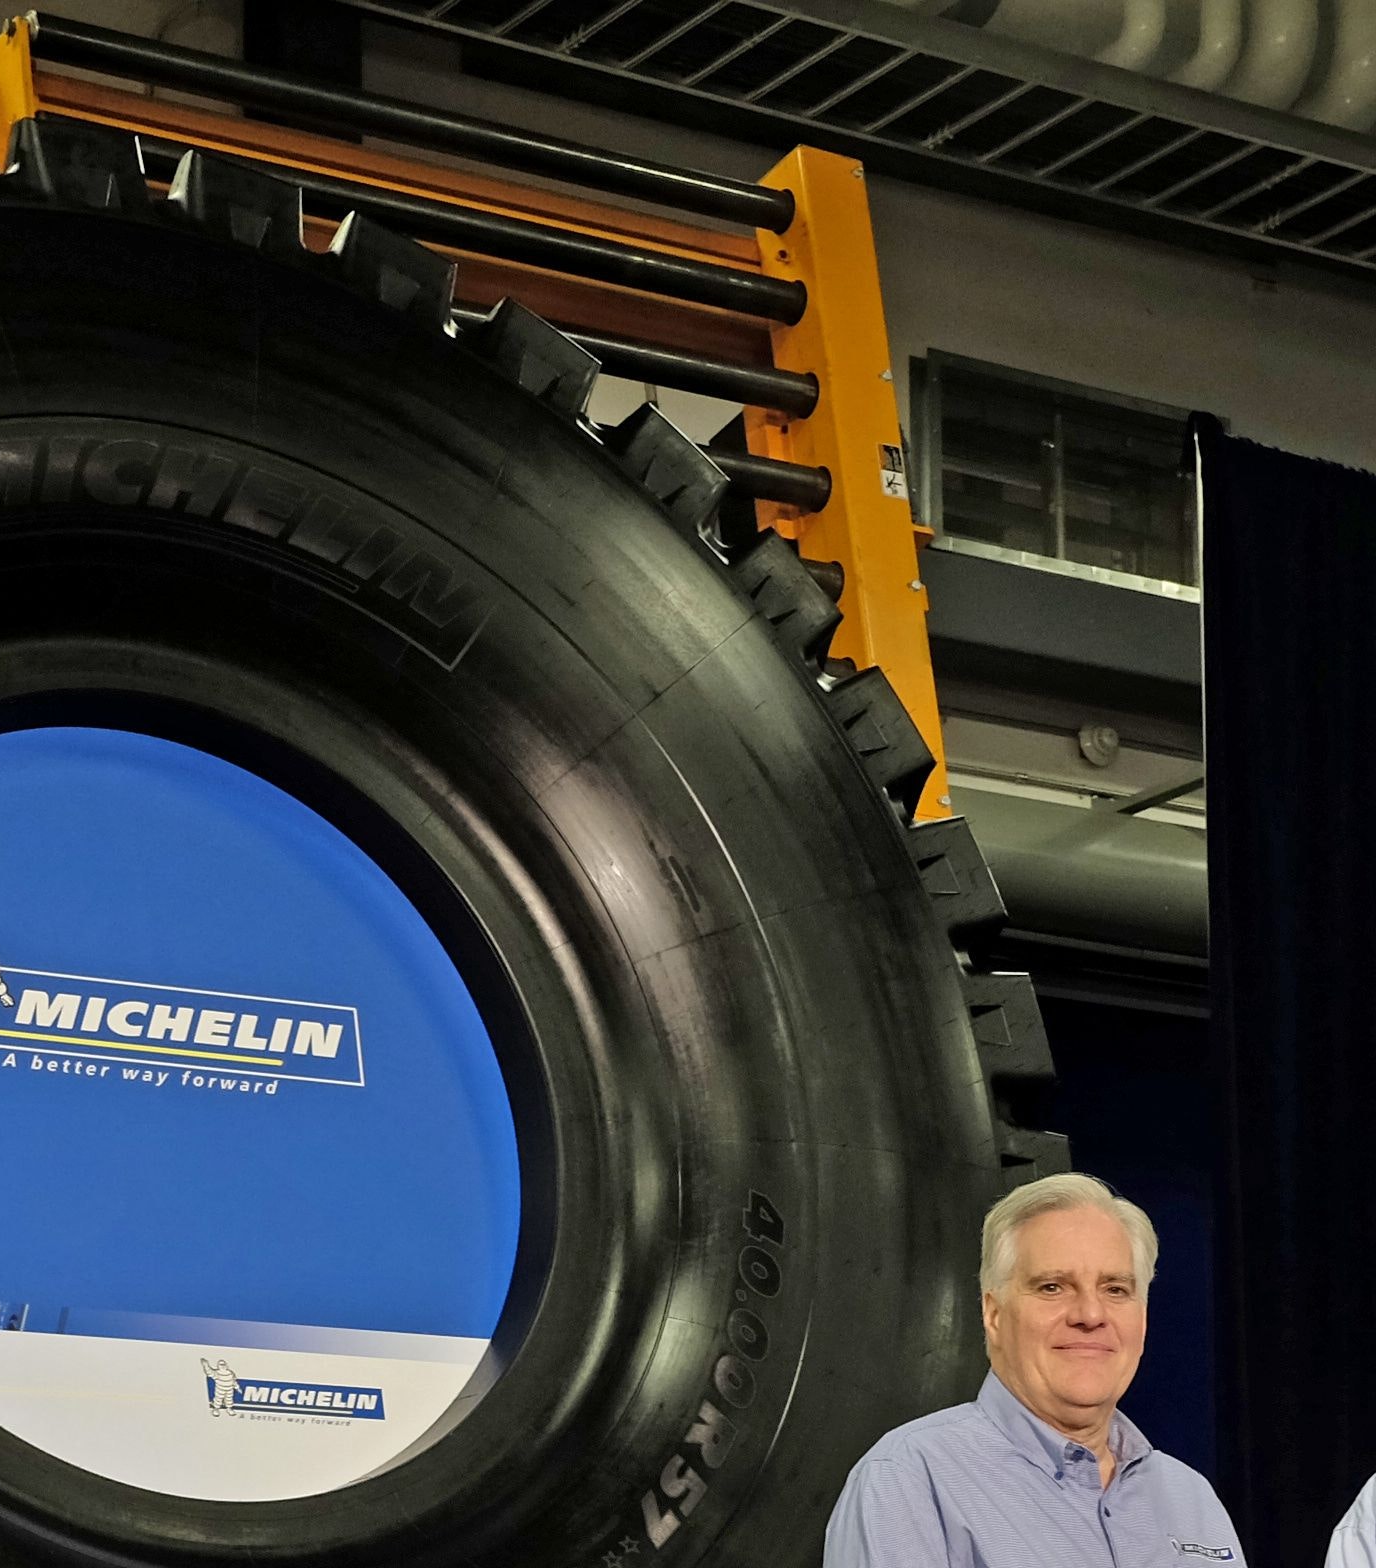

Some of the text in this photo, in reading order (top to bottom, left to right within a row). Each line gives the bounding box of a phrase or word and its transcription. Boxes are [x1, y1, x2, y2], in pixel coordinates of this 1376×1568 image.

[15, 989, 343, 1058] MICHELIN
[2, 1053, 279, 1095] A better way forward
[243, 1386, 377, 1410] MICHELIN
[287, 1417, 306, 1426] way
[311, 1417, 352, 1427] forward
